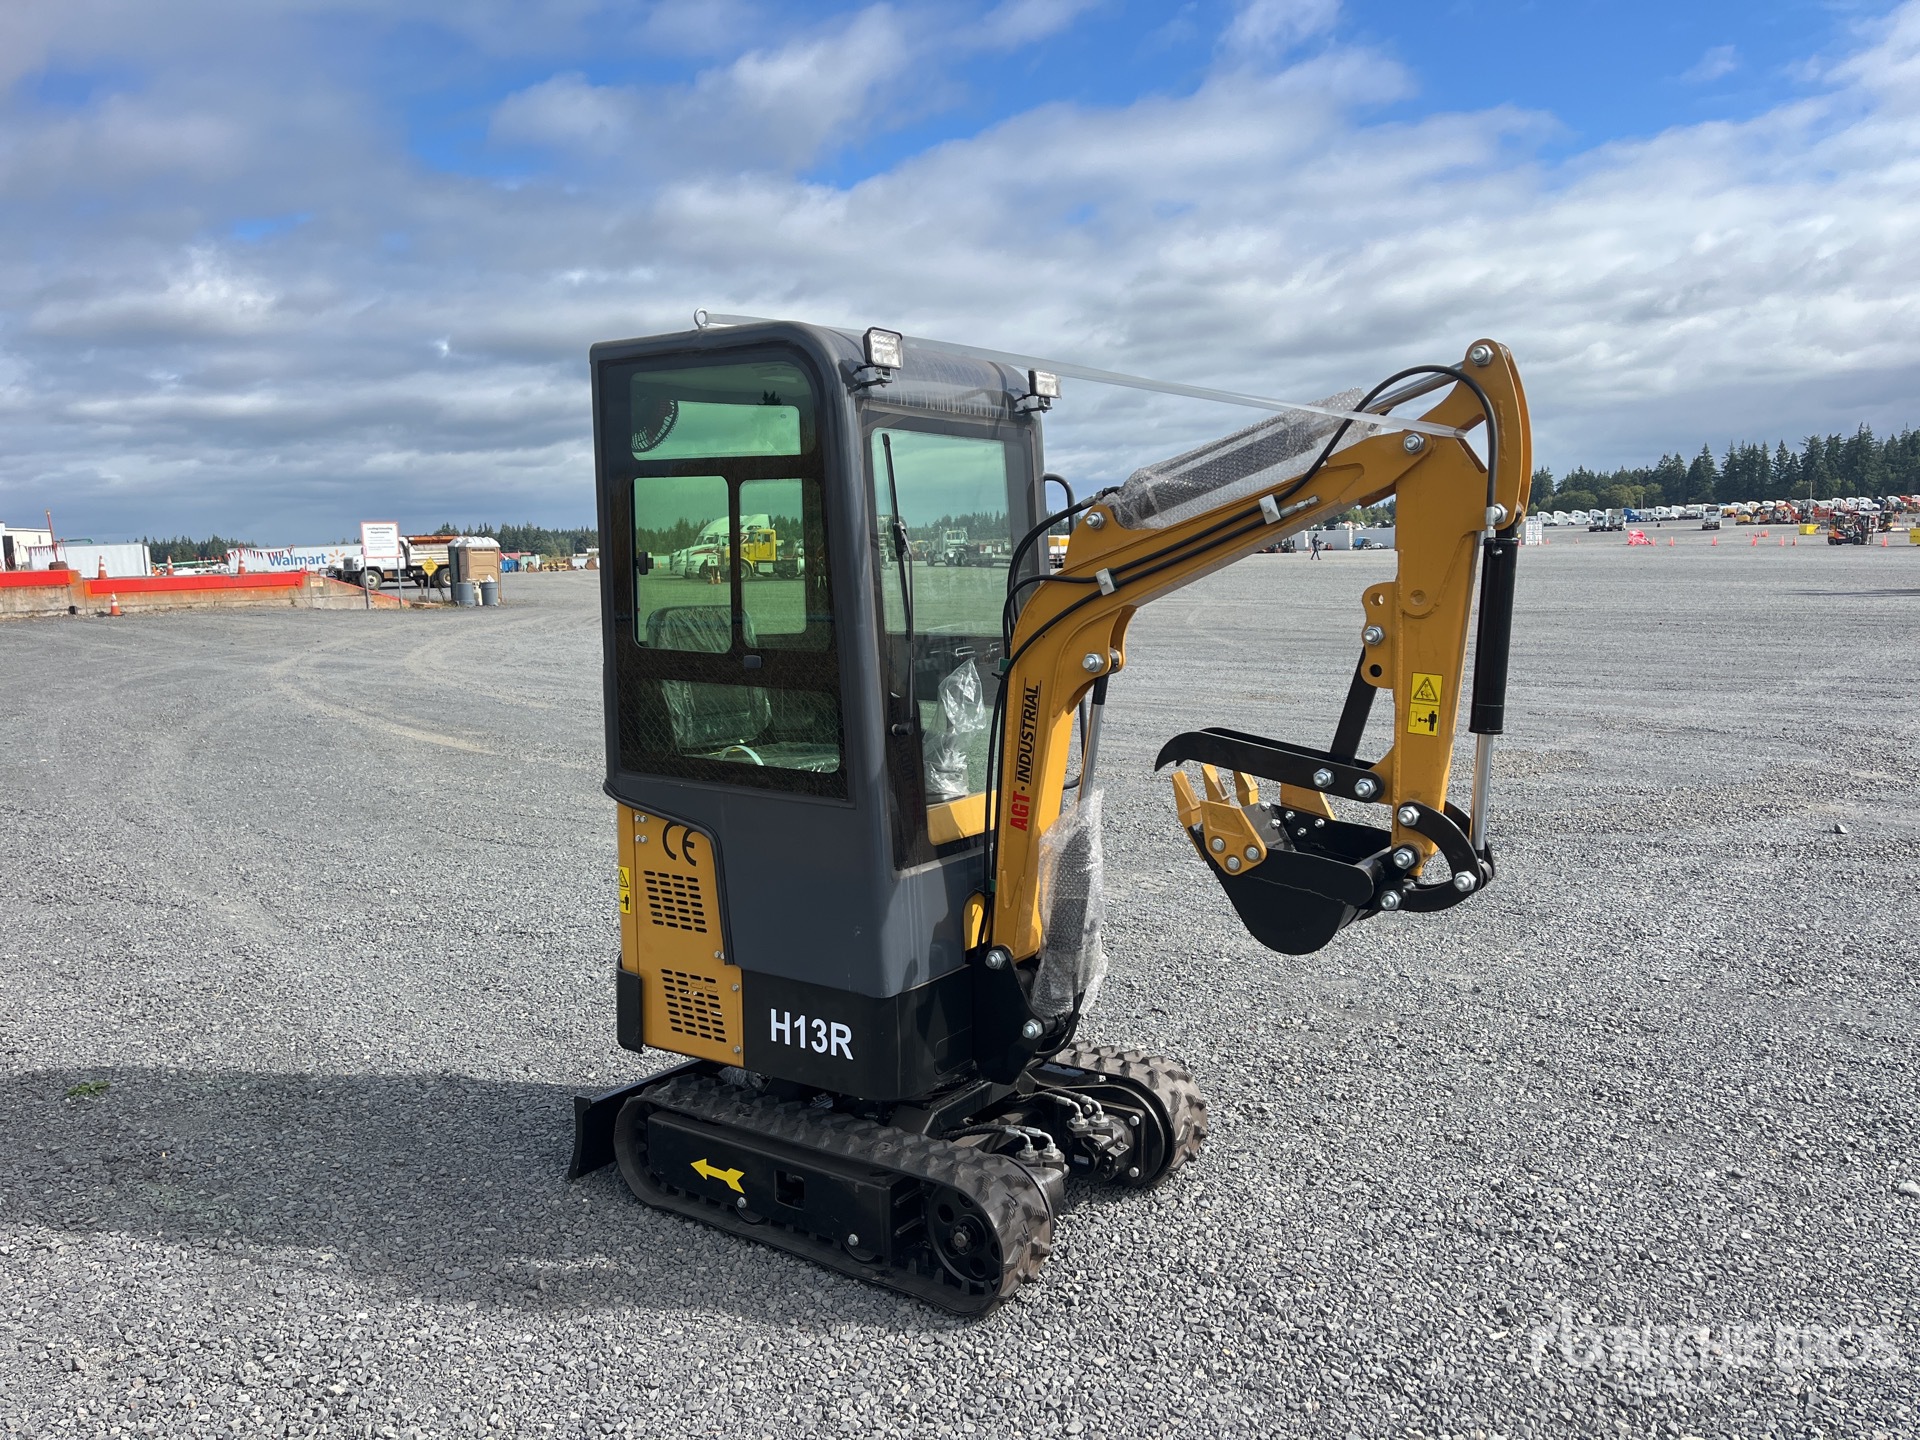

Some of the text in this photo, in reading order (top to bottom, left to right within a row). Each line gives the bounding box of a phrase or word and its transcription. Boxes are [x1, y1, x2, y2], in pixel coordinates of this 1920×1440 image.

[269, 553, 327, 567] Walmart
[1010, 685, 1039, 832] AGT INDUSTRIAL
[770, 1008, 854, 1061] H13R
